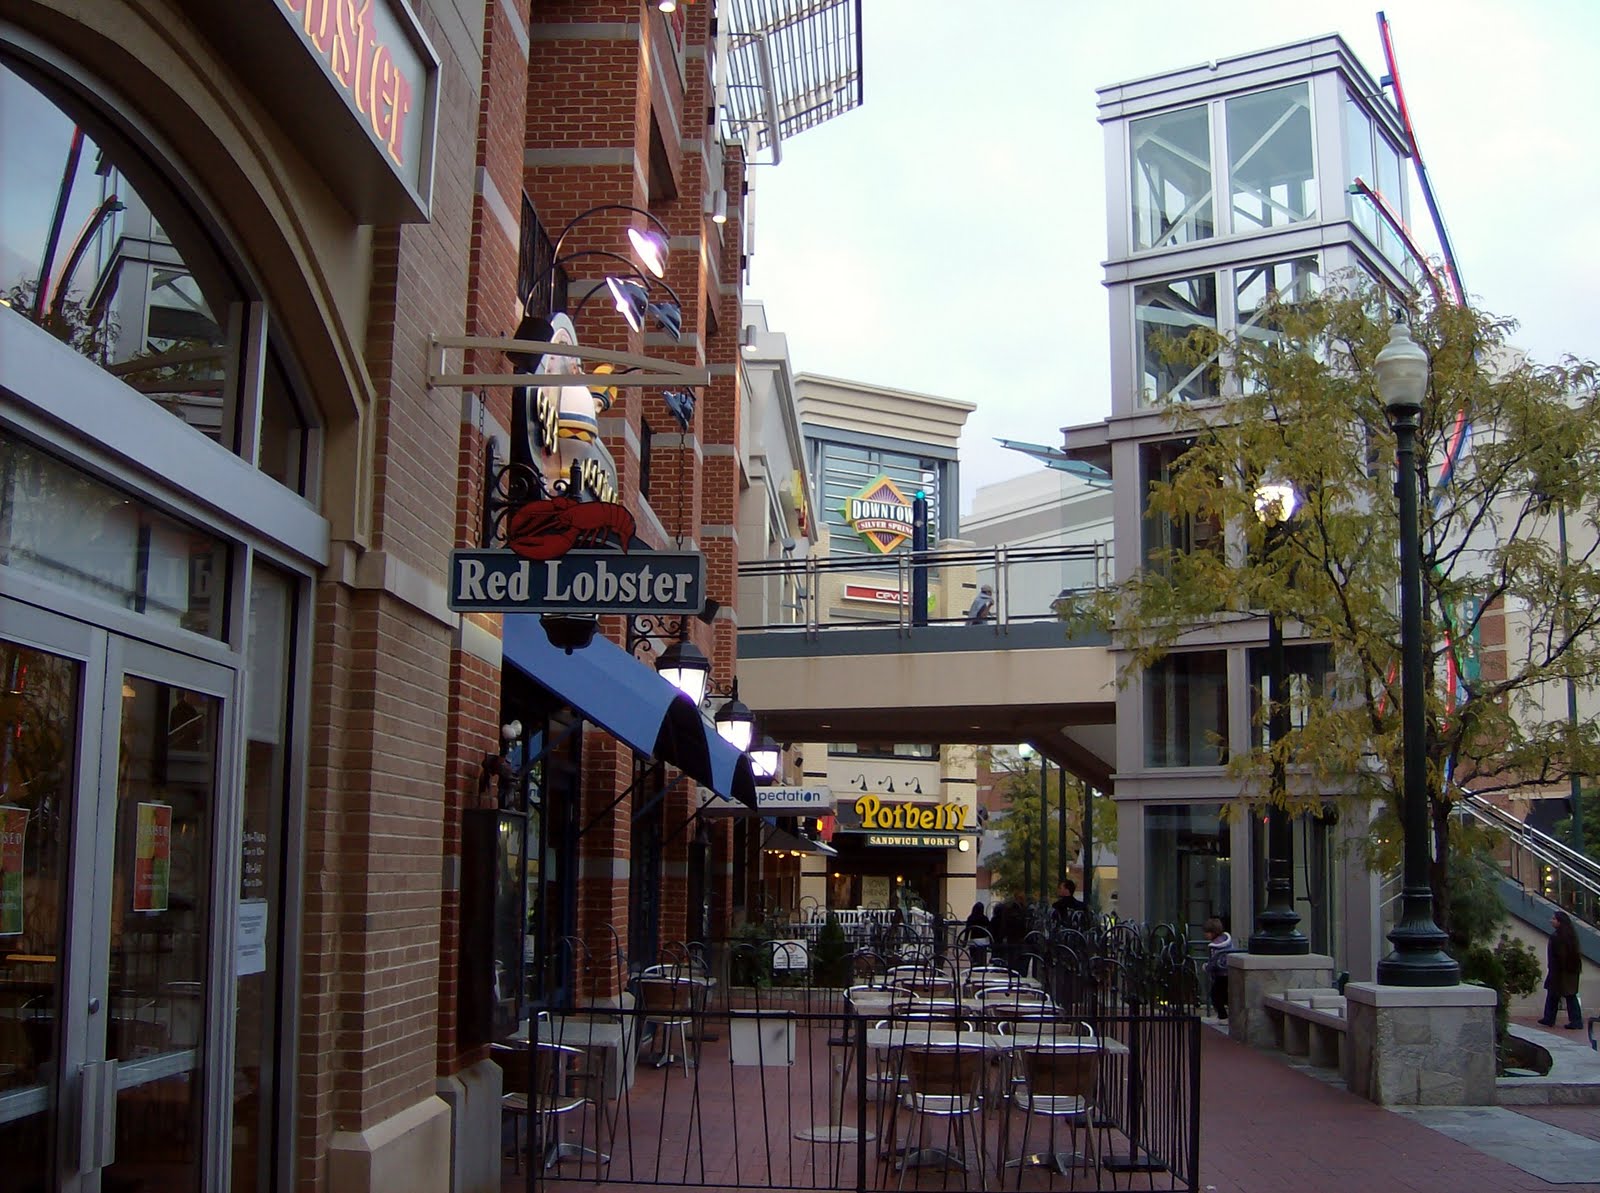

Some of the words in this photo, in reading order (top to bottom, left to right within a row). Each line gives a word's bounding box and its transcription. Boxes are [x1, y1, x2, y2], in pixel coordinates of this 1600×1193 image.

[284, 0, 413, 167] ster
[852, 500, 914, 524] DOWNTOW
[860, 521, 887, 530] SILVER
[457, 559, 531, 601] Red
[543, 560, 694, 603] Lobster
[855, 794, 970, 831] Potbelly
[870, 836, 918, 846] SANDWICH
[923, 837, 956, 847] WORKS
